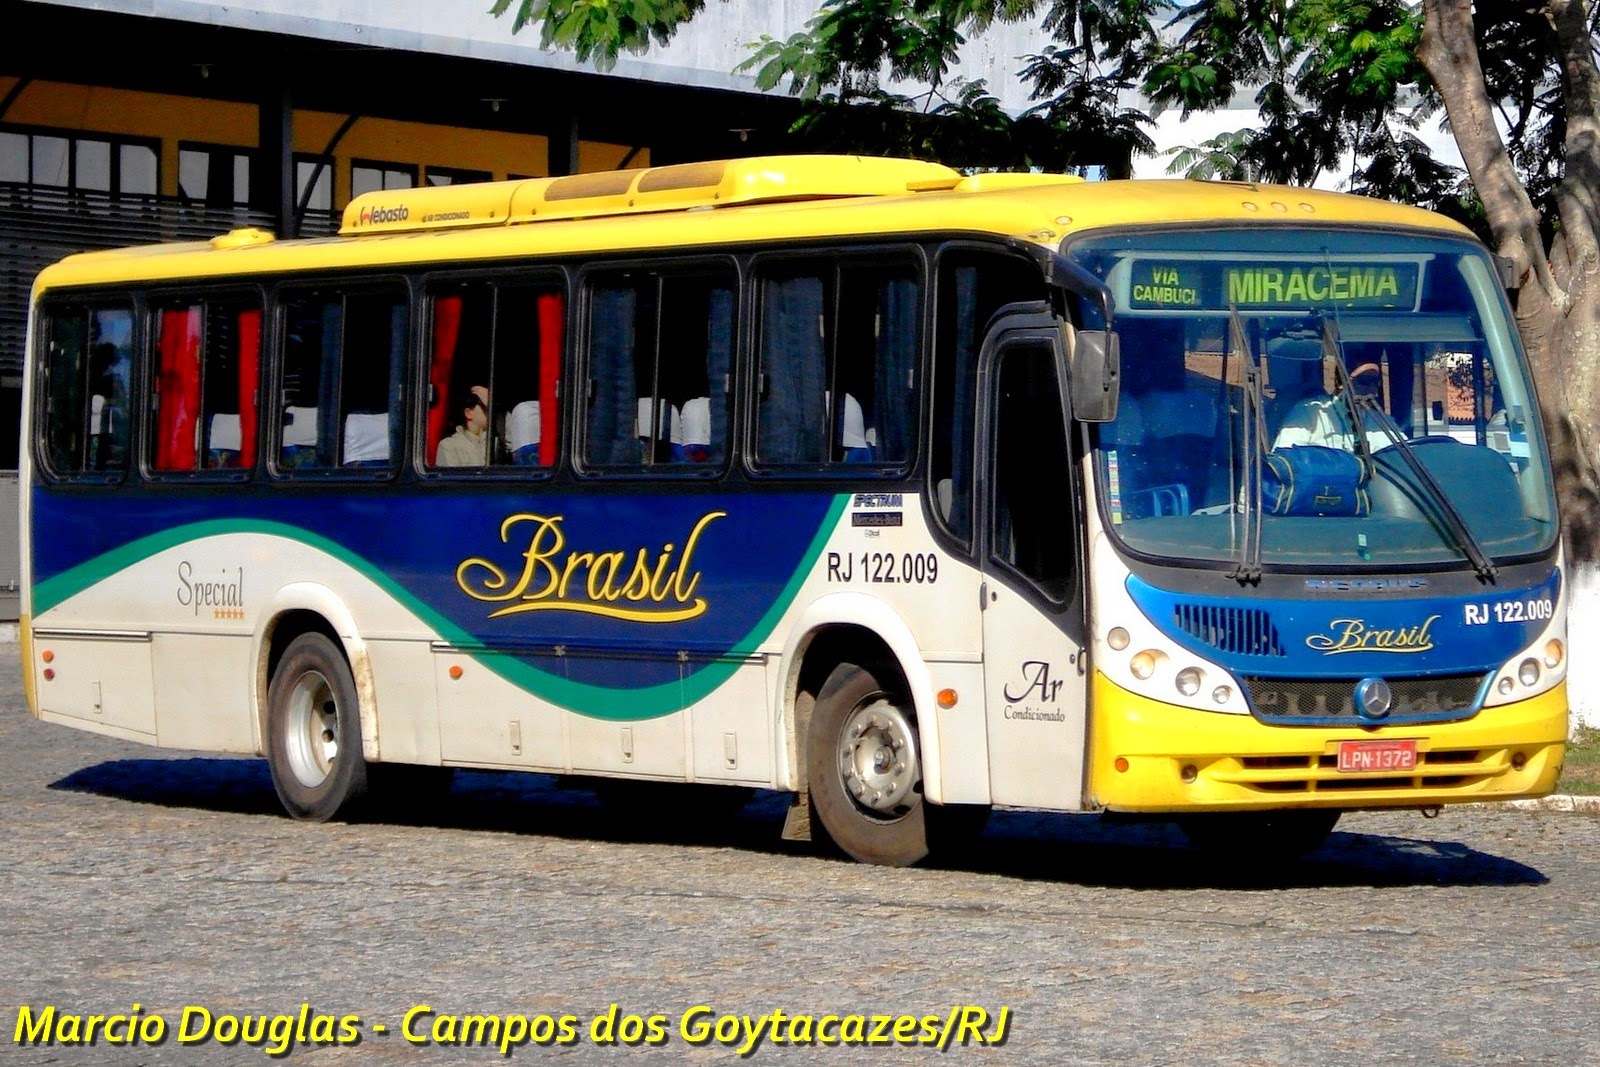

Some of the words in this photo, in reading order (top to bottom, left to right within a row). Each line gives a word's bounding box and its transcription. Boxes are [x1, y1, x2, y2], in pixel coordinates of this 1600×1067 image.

[360, 204, 408, 226] Webasto
[1152, 266, 1179, 286] VIA
[1228, 266, 1398, 303] MIRACEMA
[1133, 285, 1196, 305] CAMBUCI
[456, 512, 727, 622] Brasil
[828, 552, 852, 582] RJ
[861, 552, 938, 583] 122.009
[177, 561, 243, 616] Special
[1465, 603, 1489, 625] RJ
[1494, 599, 1553, 622] 122.009
[1306, 614, 1441, 655] Brasil
[1003, 661, 1063, 703] Ar
[1004, 705, 1065, 722] Condicionado
